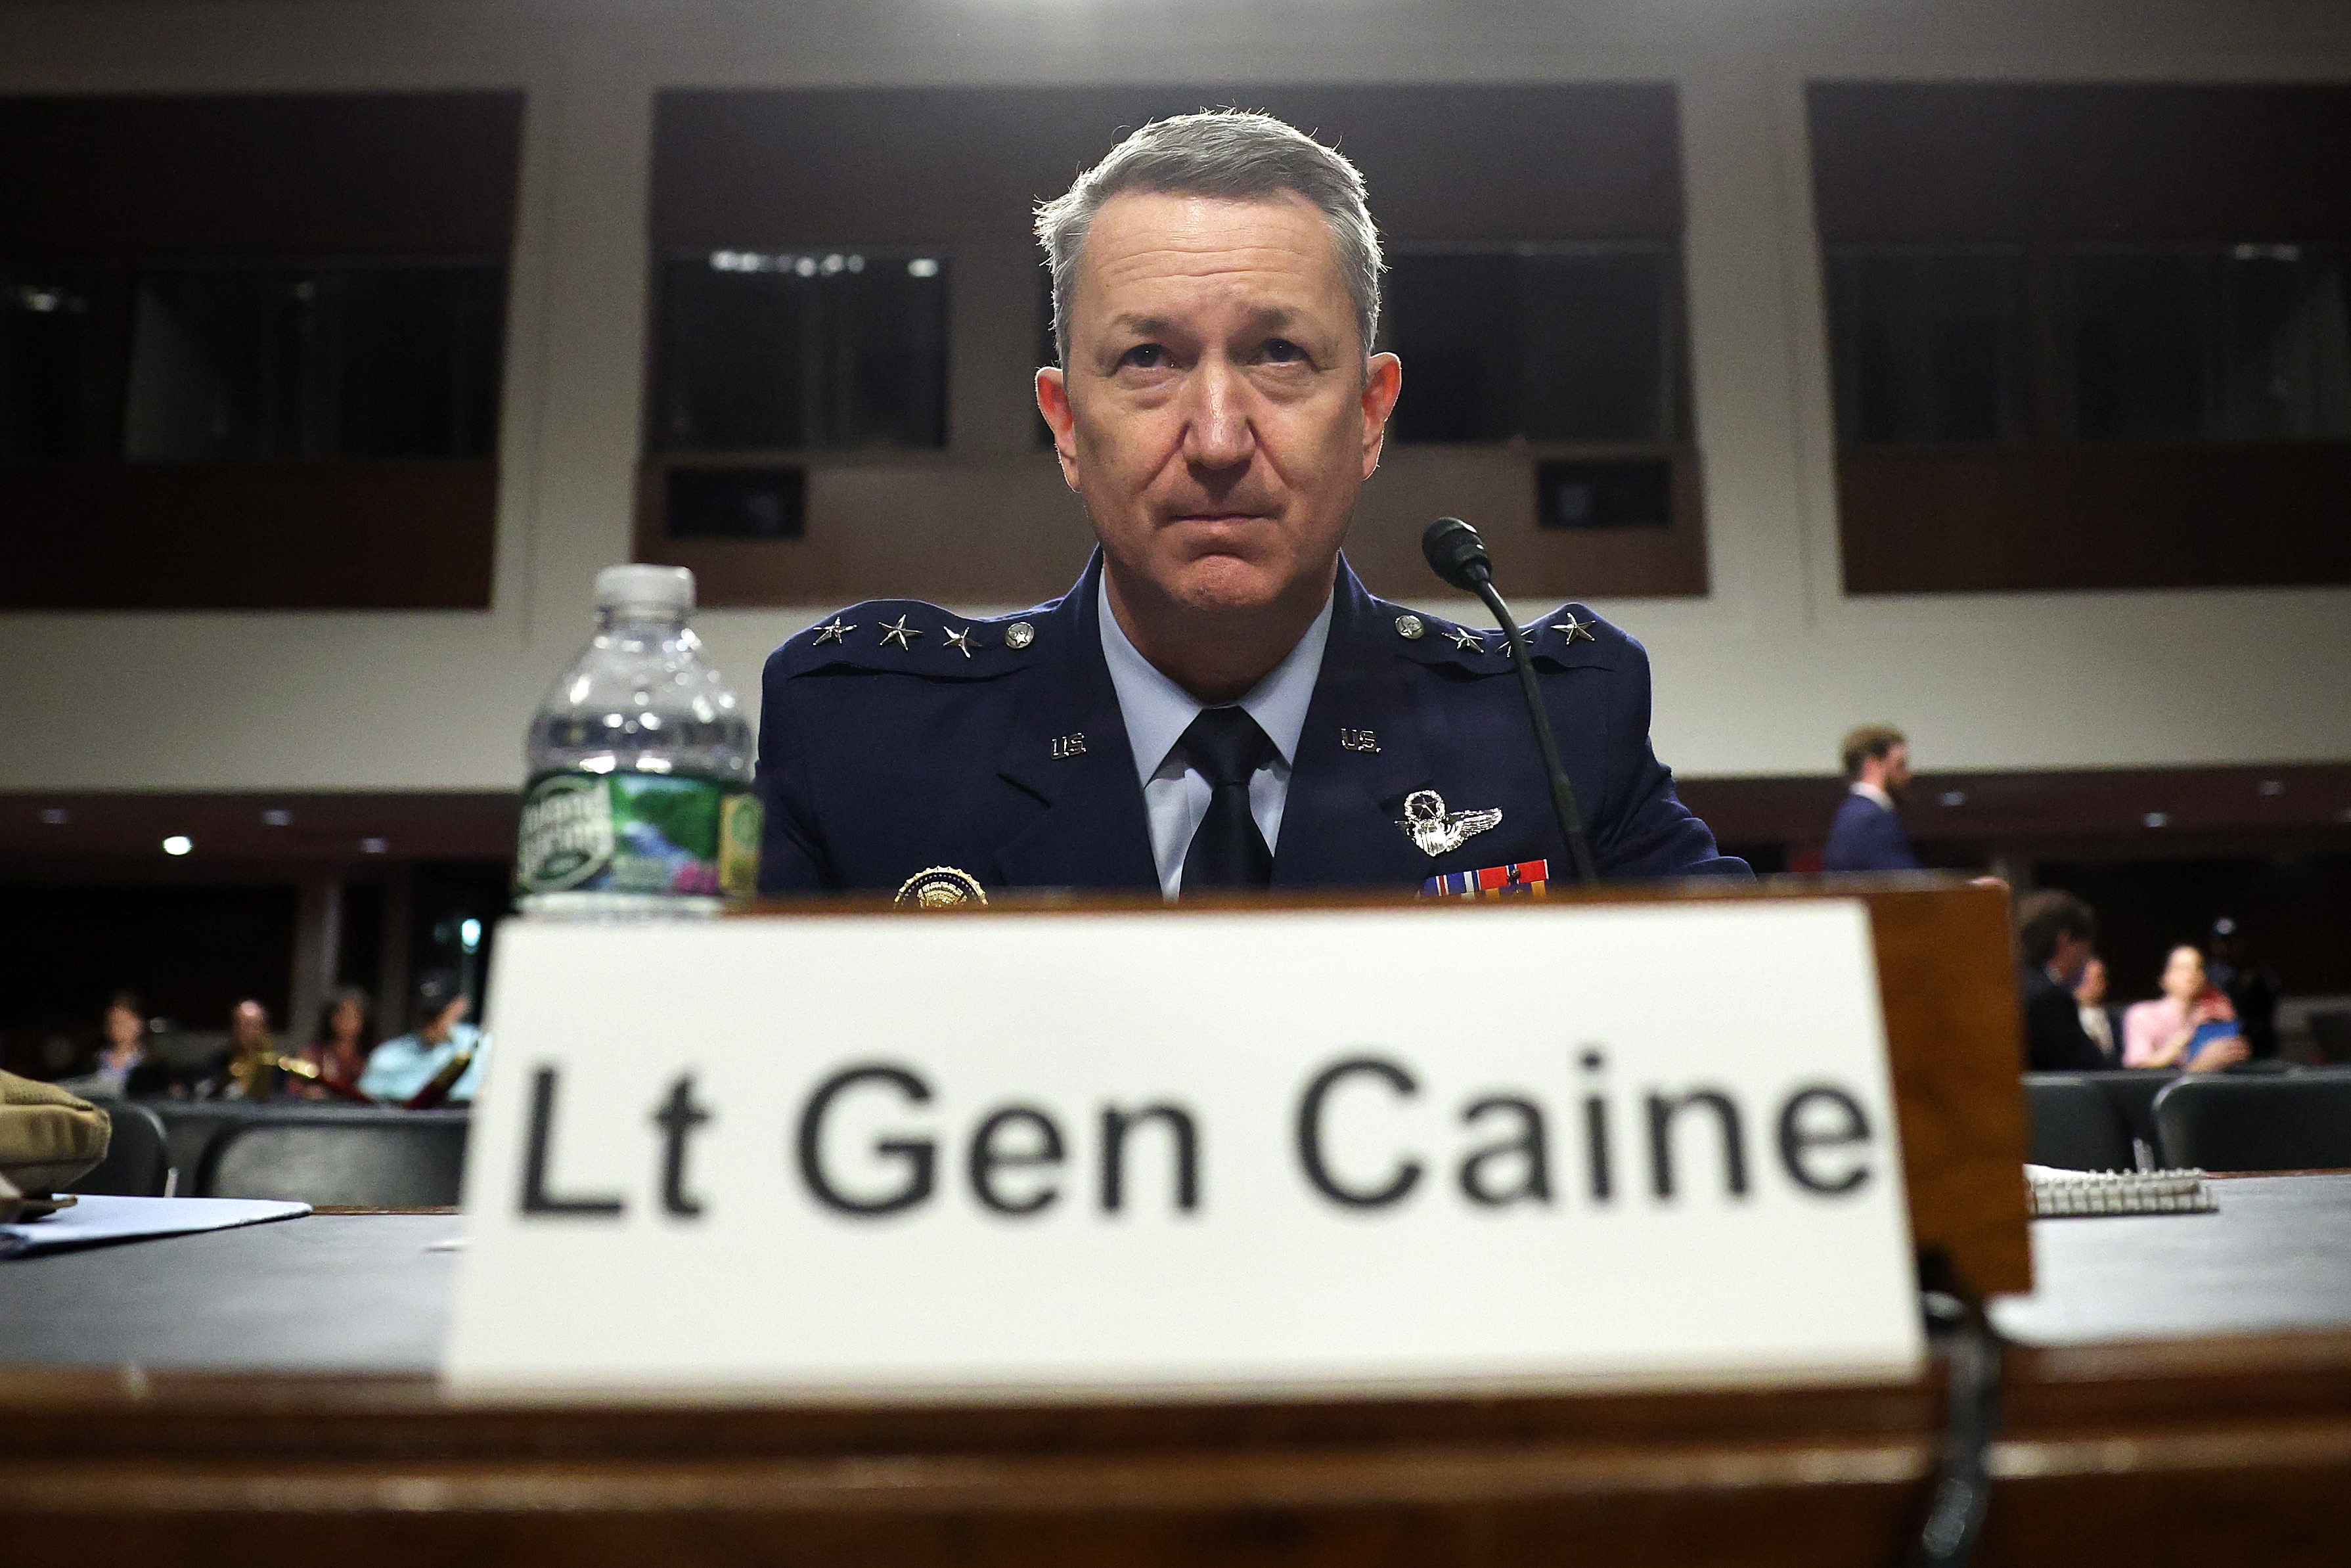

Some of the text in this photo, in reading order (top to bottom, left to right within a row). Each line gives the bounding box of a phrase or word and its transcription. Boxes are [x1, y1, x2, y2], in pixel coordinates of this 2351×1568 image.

[515, 1045, 1875, 1222] Lt Gen Caine
